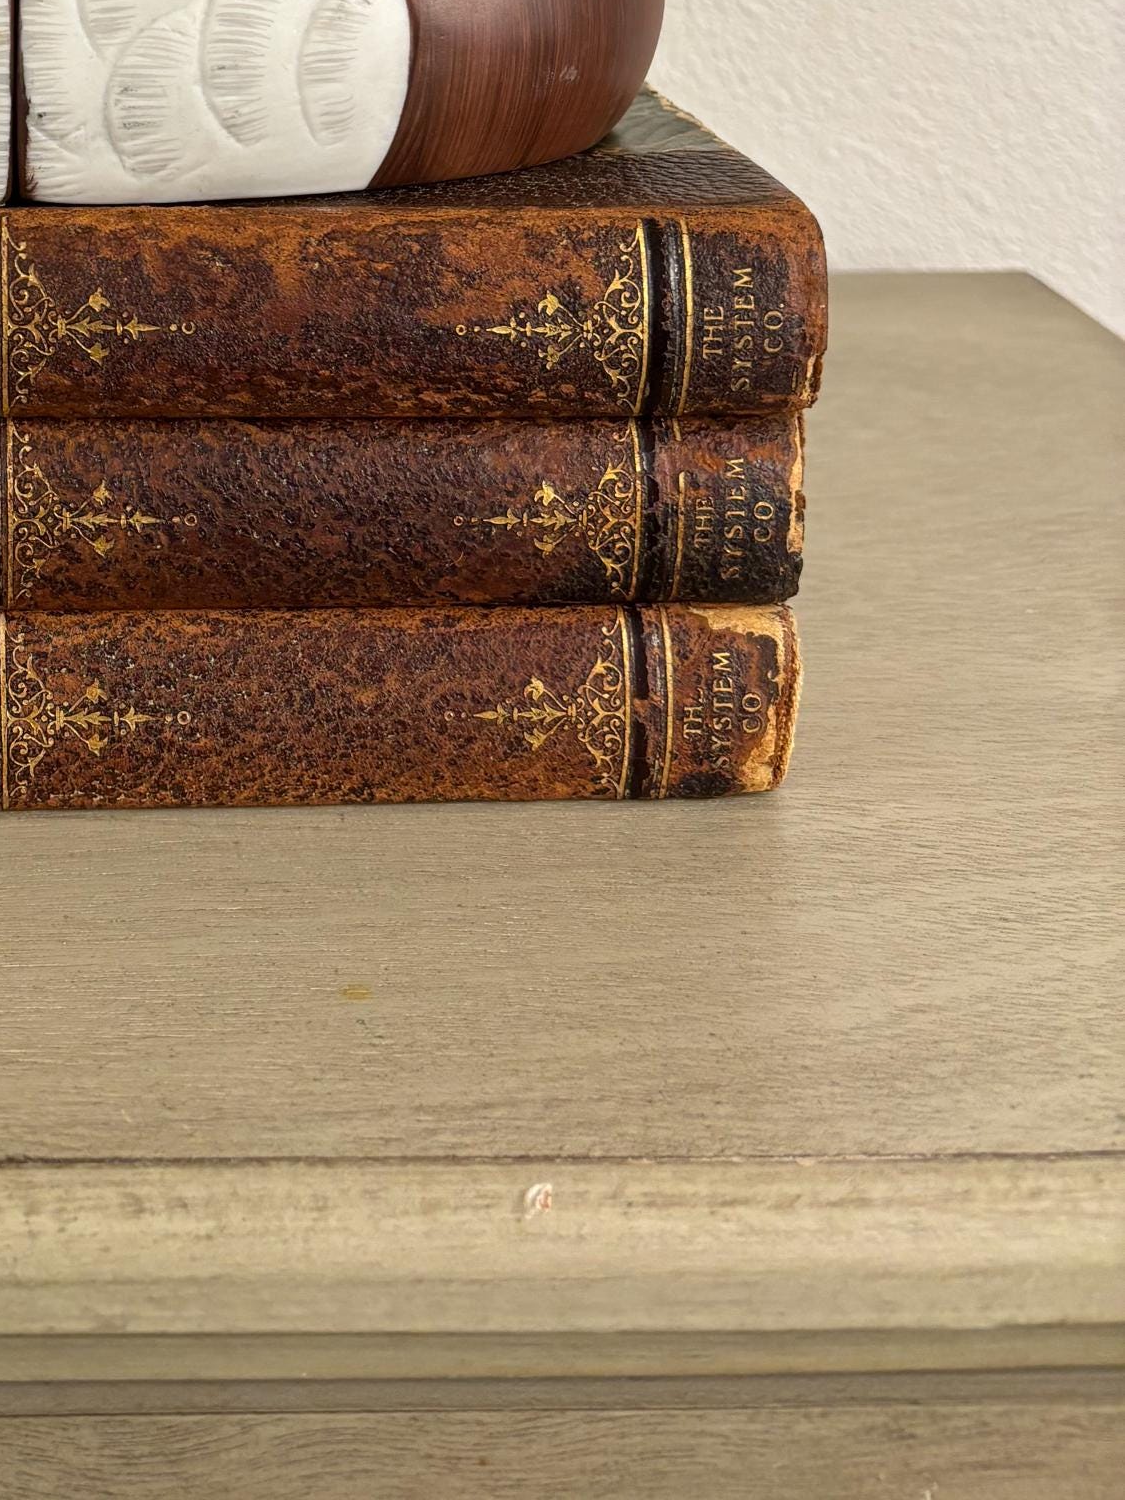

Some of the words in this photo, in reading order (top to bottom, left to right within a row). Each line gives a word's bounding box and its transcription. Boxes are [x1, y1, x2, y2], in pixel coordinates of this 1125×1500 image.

[702, 305, 724, 359] THE
[731, 267, 755, 392] SYSTEM
[763, 303, 785, 354] CO.
[694, 496, 714, 548] THE
[711, 652, 733, 769] SYSTEM
